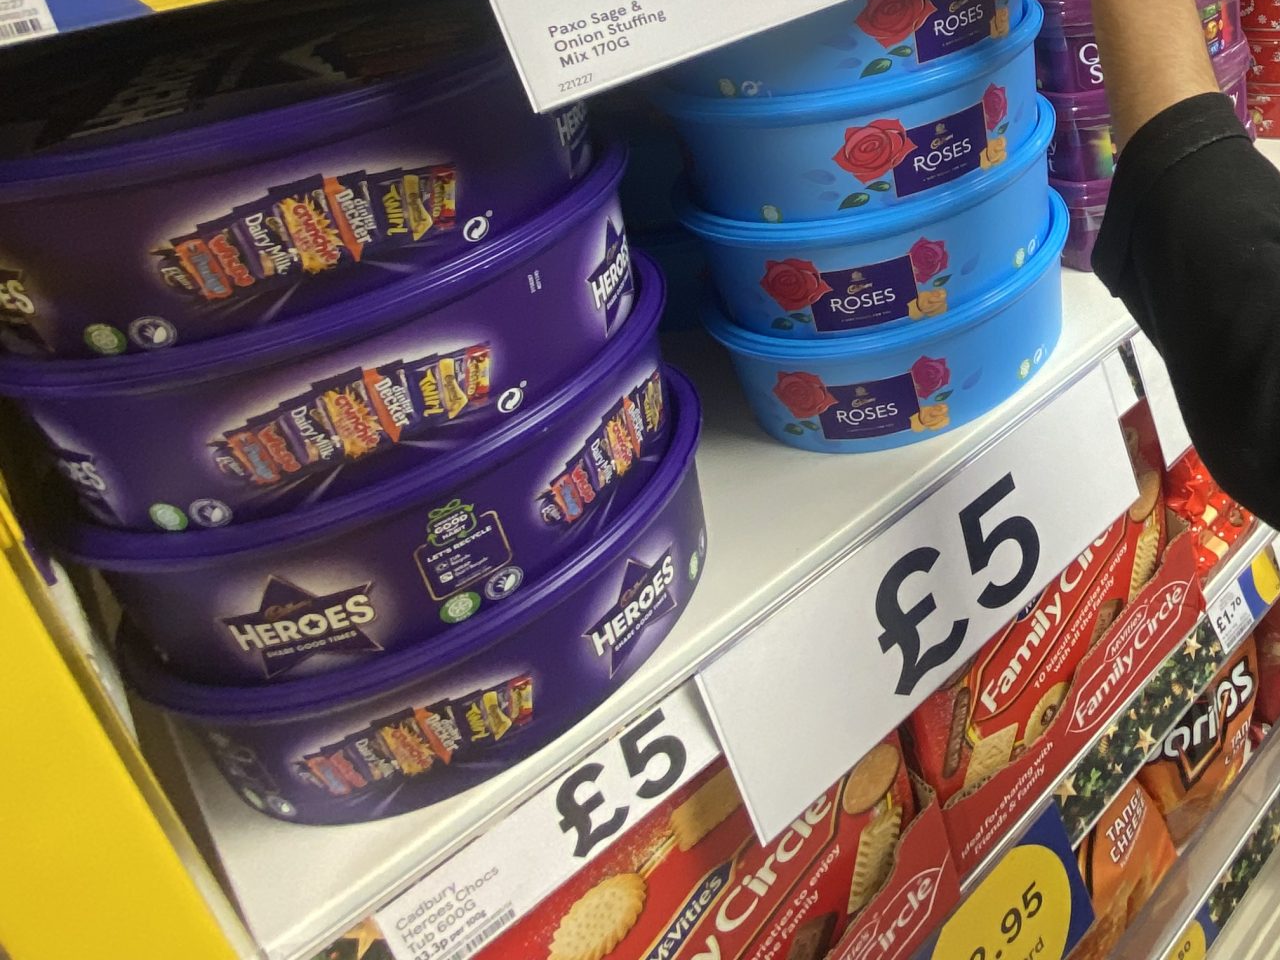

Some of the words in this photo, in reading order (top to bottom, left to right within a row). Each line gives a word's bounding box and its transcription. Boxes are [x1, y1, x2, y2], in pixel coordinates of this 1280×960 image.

[547, 19, 587, 38] Paxo
[591, 6, 626, 25] Sage
[631, 0, 642, 12] &
[554, 29, 605, 52] Onion
[607, 10, 667, 35] Stuffing
[933, 3, 984, 37] ROSES
[559, 51, 589, 68] Mix
[591, 36, 630, 57] 170G
[558, 72, 593, 92] 221227
[913, 137, 972, 172] ROSES
[244, 212, 271, 248] Dairy
[265, 242, 291, 276] Milk
[830, 287, 896, 314] ROSES
[291, 405, 315, 442] Dairy
[311, 432, 337, 461] Milk
[835, 402, 898, 426] ROSES
[590, 438, 605, 466] Dairy
[427, 547, 452, 563] LET'S
[453, 525, 493, 550] RECYCLE
[434, 513, 468, 534] GOOD
[591, 555, 674, 657] HEROES
[875, 471, 1040, 696] £5
[228, 594, 375, 651] HEROES
[615, 631, 635, 651] SHARE
[636, 610, 653, 630] GOOD
[1033, 673, 1047, 689] 10
[1046, 633, 1072, 671] biscuit
[1070, 583, 1101, 633] varieties
[1099, 571, 1110, 585] to
[1108, 542, 1129, 573] enjoy
[1052, 648, 1072, 673] with
[1070, 630, 1081, 647] all
[1080, 612, 1093, 631] the
[1092, 576, 1115, 614] family
[1216, 596, 1242, 632] £1.70
[296, 639, 327, 652] GOOD
[980, 591, 1062, 713] Family
[1074, 649, 1134, 727] Family
[1133, 585, 1184, 651] Circle
[355, 738, 376, 767] Dairy
[554, 708, 688, 859] £5
[961, 830, 986, 860] Ideal
[984, 808, 1001, 831] for
[999, 767, 1035, 814] sharing
[1032, 742, 1054, 769] with
[974, 811, 1008, 855] Friends
[1007, 799, 1018, 812] &
[1015, 765, 1046, 804] family
[714, 794, 832, 933] Circle
[793, 888, 809, 907] to
[808, 843, 841, 888] enjoy
[395, 882, 457, 931] Cadbury
[401, 901, 454, 944] Heroes
[455, 866, 499, 903] Chocs
[407, 930, 436, 956] Tub
[436, 899, 477, 934] 600G
[450, 926, 465, 942] per
[466, 909, 488, 928] 100g
[782, 889, 820, 939] family
